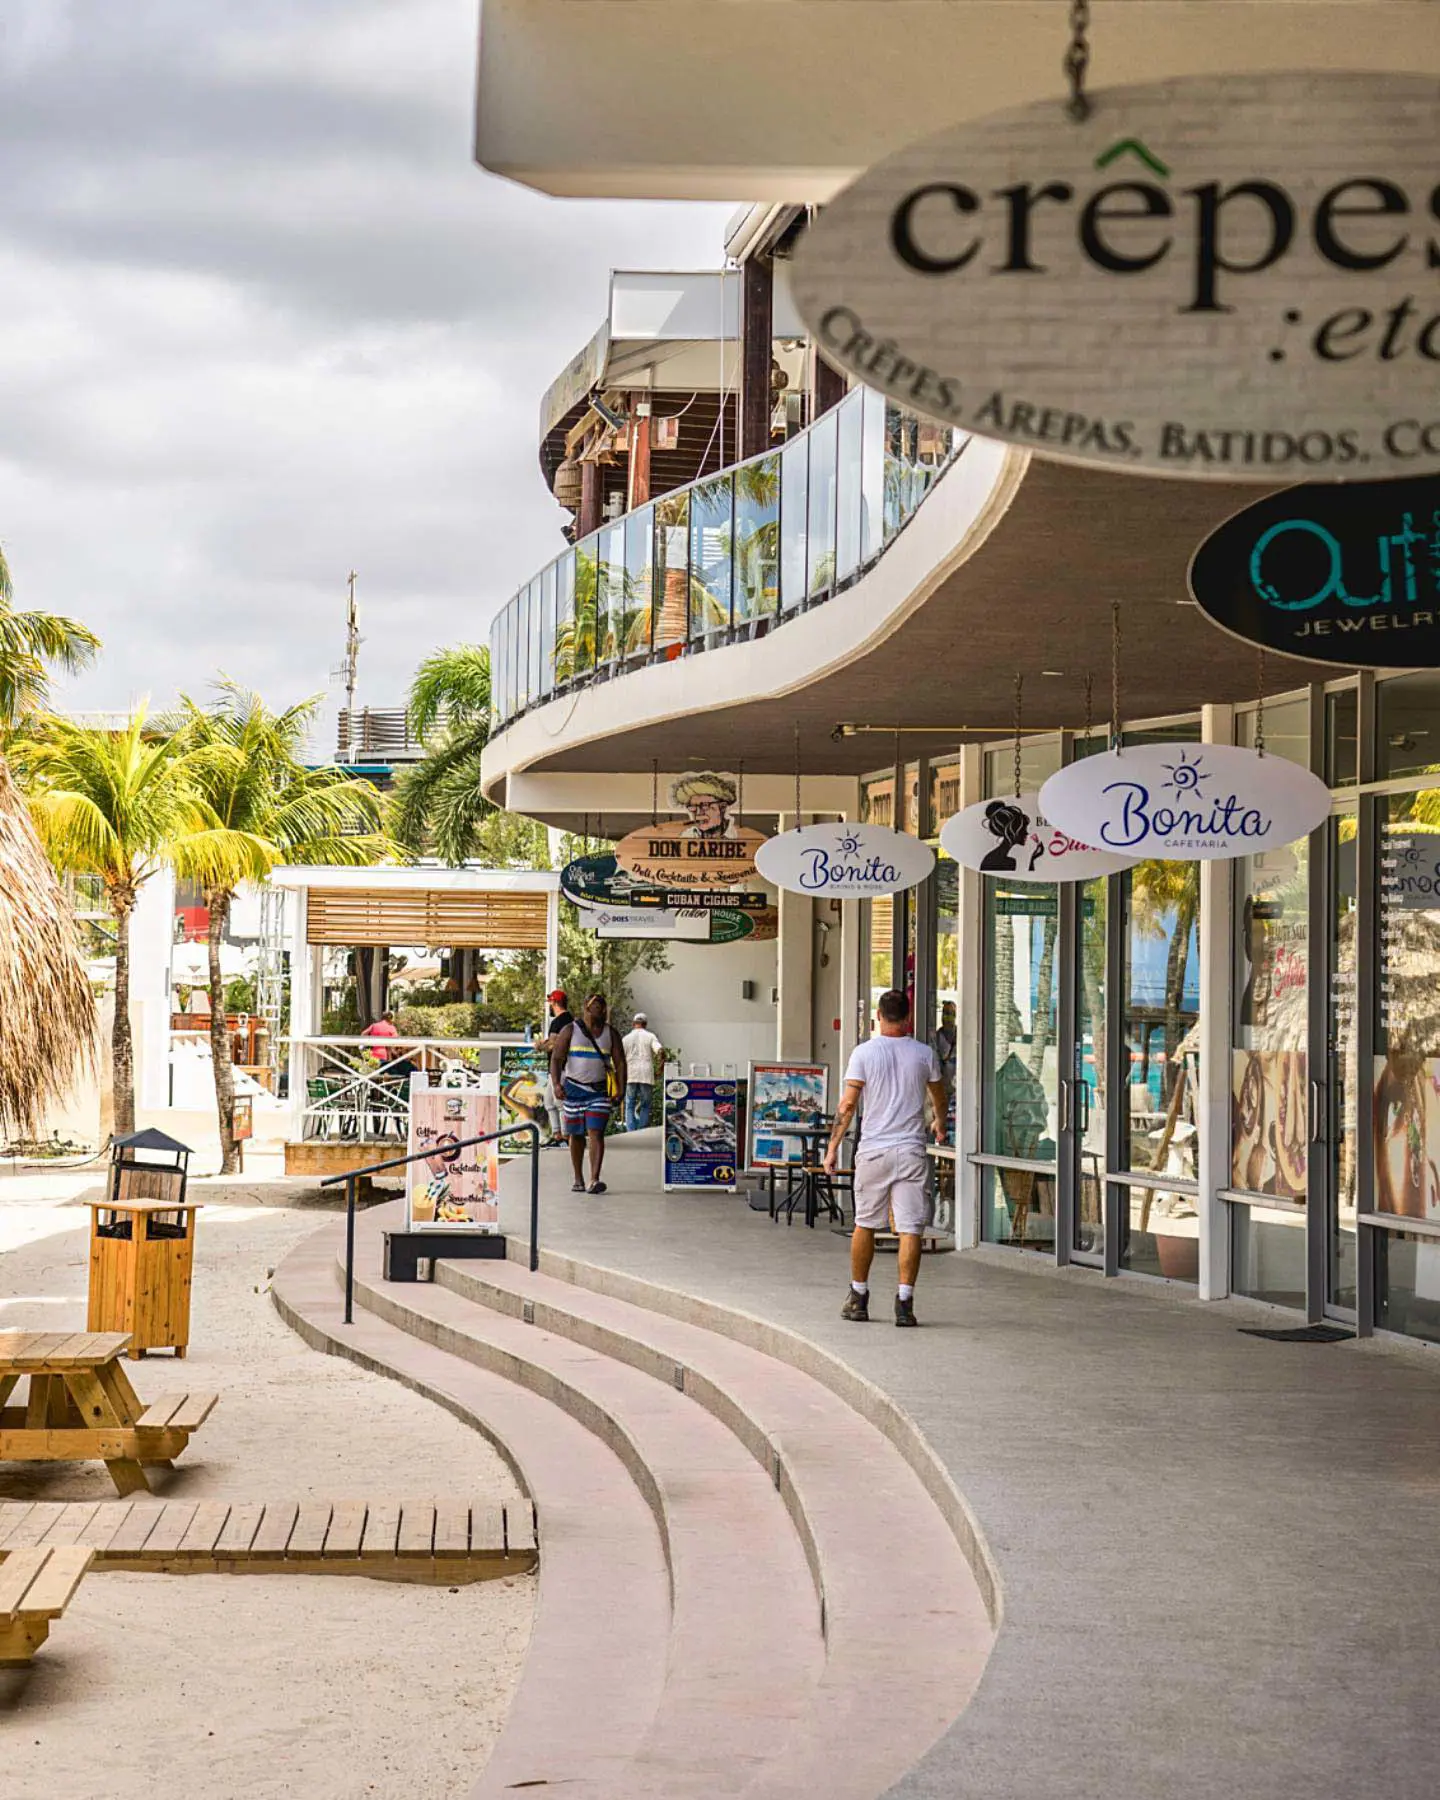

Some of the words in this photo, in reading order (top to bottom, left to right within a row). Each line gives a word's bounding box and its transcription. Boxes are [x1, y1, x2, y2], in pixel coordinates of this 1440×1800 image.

[1293, 610, 1440, 636] JEWELR
[1100, 782, 1272, 847] Bonita
[648, 840, 682, 858] DON
[687, 841, 746, 858] CARIBE
[1164, 839, 1228, 849] CAFETARIA
[656, 868, 698, 885] Cocktails
[701, 871, 714, 883] &
[799, 848, 901, 889] Bonita
[667, 894, 701, 905] CUBAN
[703, 895, 740, 906] CIGARS
[416, 1127, 438, 1137] Coffee
